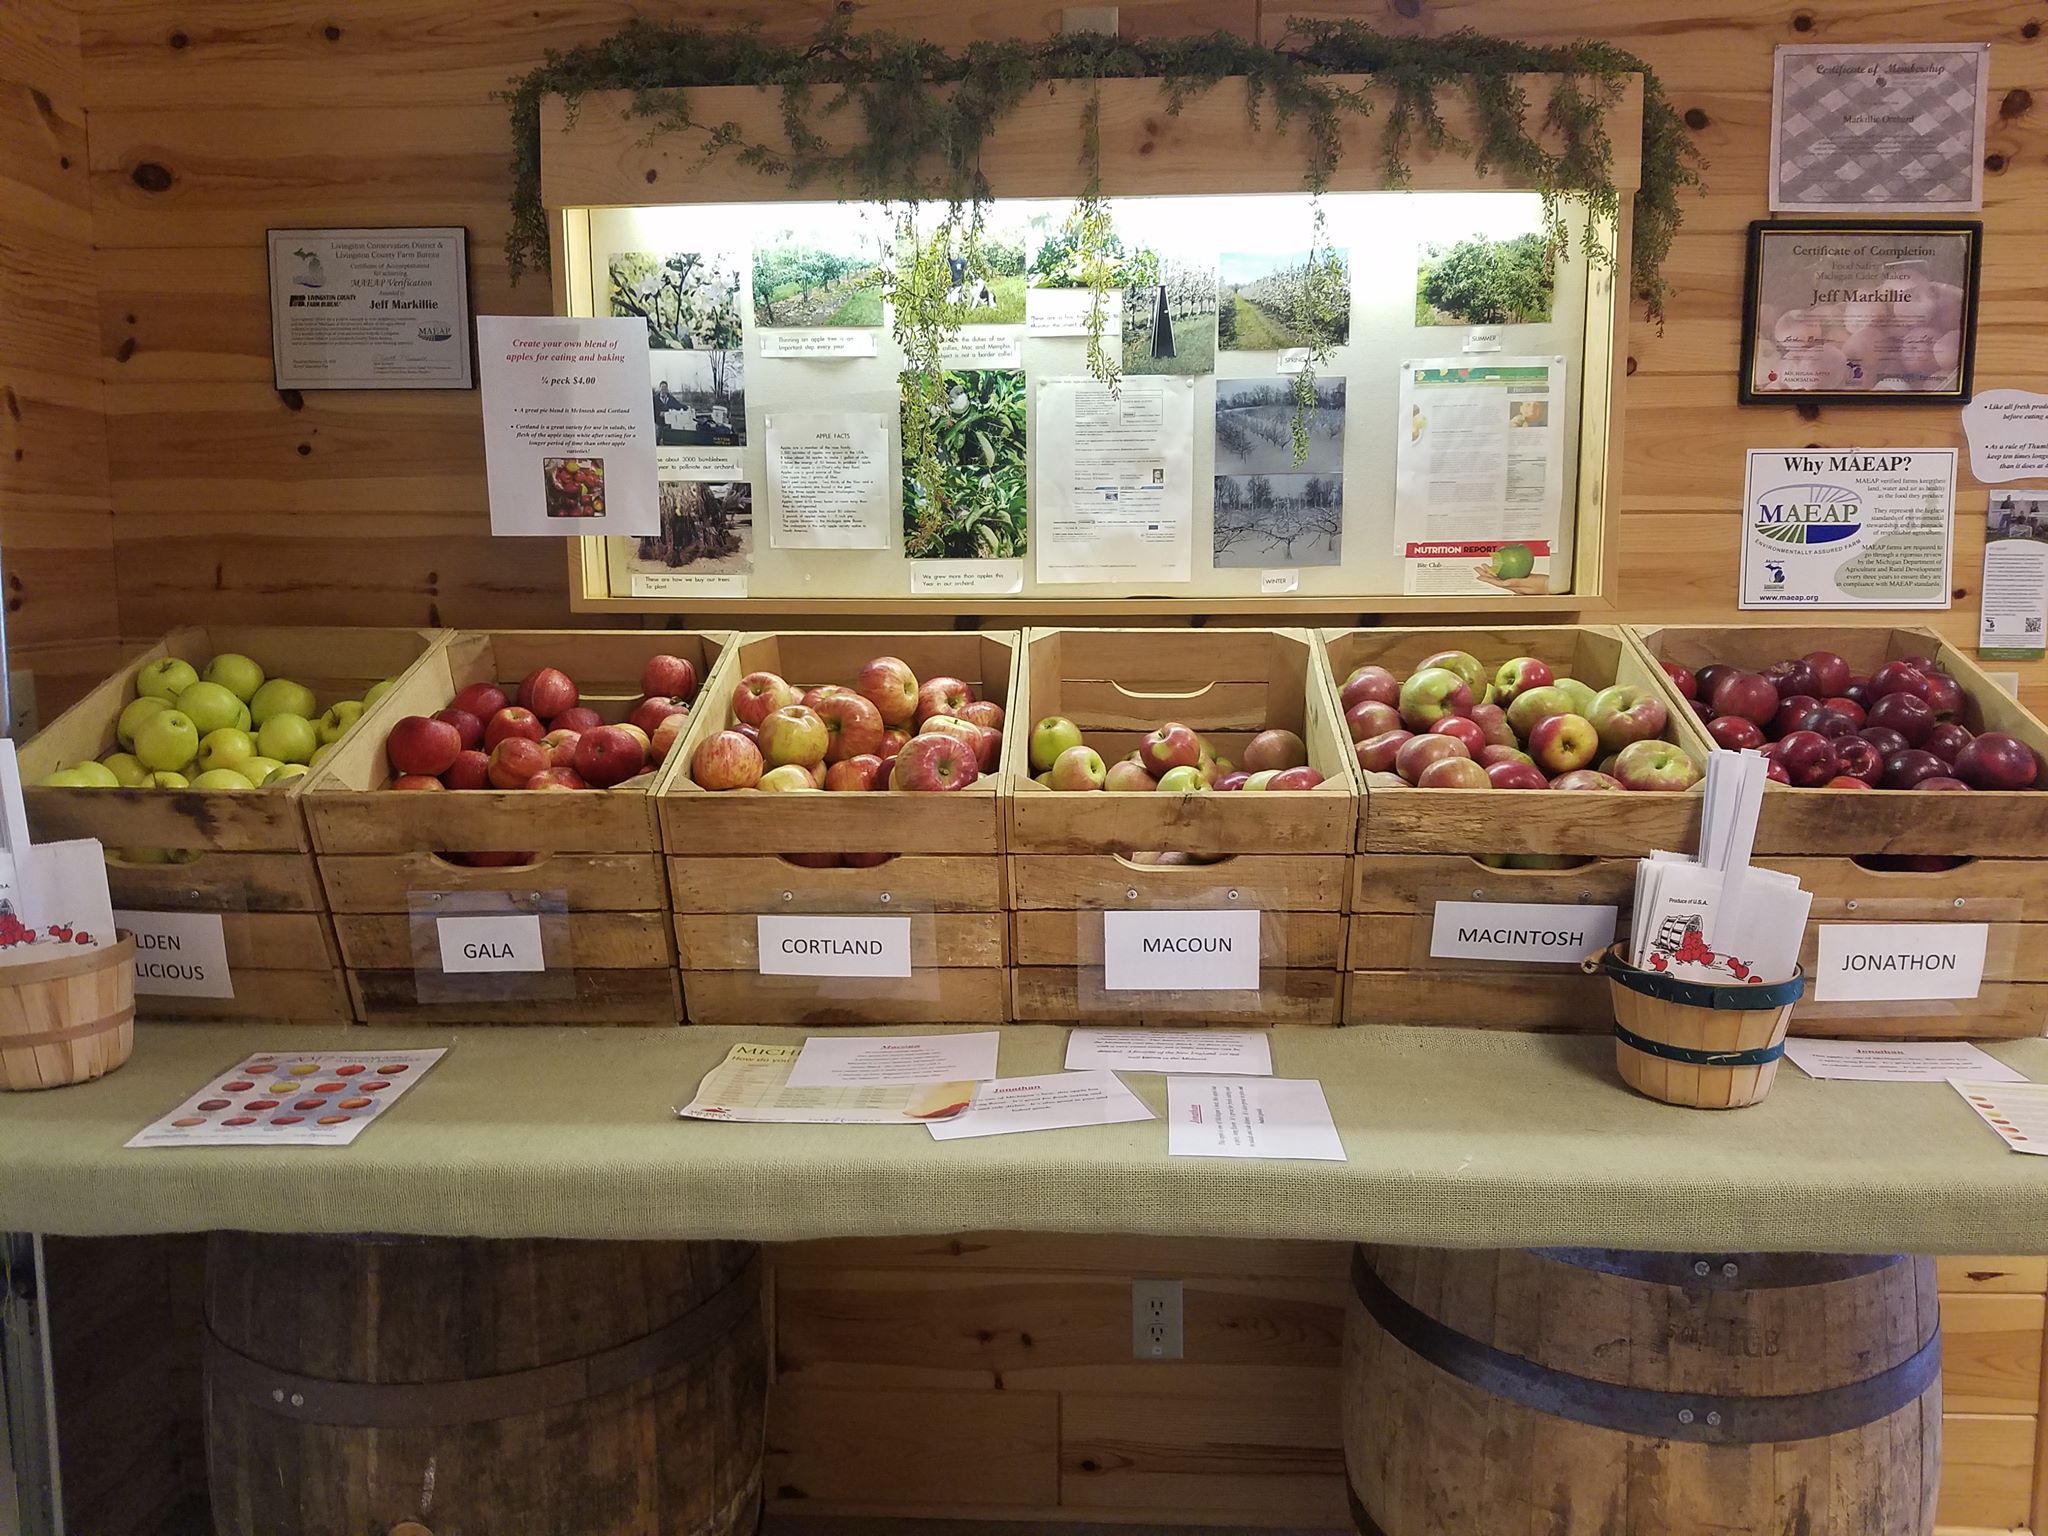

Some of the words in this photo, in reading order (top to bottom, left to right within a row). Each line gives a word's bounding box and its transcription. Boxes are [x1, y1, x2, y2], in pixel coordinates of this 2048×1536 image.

[1816, 64, 1866, 75] Certificate
[1868, 64, 1879, 76] of
[1884, 63, 1945, 75] Membership
[331, 242, 366, 250] Livingston
[411, 241, 436, 249] District
[335, 251, 370, 259] Livingston
[371, 251, 395, 259] County
[1793, 245, 1851, 257] Certificate
[1854, 245, 1865, 256] of
[1870, 245, 1936, 259] Completion
[388, 279, 433, 289] Verification
[1811, 289, 1840, 306] Jeff
[1843, 289, 1912, 303] Markillie
[369, 299, 390, 310] Jeff
[391, 299, 439, 310] Markillie
[1471, 334, 1497, 343] SUMMER
[512, 339, 541, 348] Create
[542, 340, 562, 350] your
[584, 340, 607, 348] blend
[609, 340, 618, 350] of
[506, 353, 534, 363] apples
[535, 353, 549, 363] for
[551, 353, 577, 363] eating
[578, 353, 595, 361] and
[597, 353, 625, 363] baking
[550, 376, 571, 387] peck
[573, 376, 596, 385] $4.00
[2013, 403, 2031, 411] fresh
[2031, 403, 2048, 411] prod
[2002, 413, 2023, 421] before
[2019, 443, 2026, 451] of
[1986, 453, 2001, 461] keep
[1784, 456, 1824, 475] Why
[1828, 456, 1912, 472] MAEAP?
[1759, 504, 1858, 523] MAEAP
[1414, 546, 1462, 554] NUTRITION
[1463, 545, 1498, 553] REPORT
[1754, 538, 1813, 555] ENVIRONMENTALLY
[1813, 546, 1843, 554] ASSURED
[1844, 538, 1862, 550] FARM
[977, 572, 994, 580] apples
[1265, 577, 1287, 585] WINTER
[135, 933, 181, 951] LDEN
[1458, 928, 1584, 947] MACINTOSH
[781, 939, 883, 955] CORTLAND
[1143, 937, 1232, 953] MACOUN
[463, 943, 515, 959] GALA
[1842, 954, 1956, 971] JONATHON
[135, 962, 204, 981] LICIOUS
